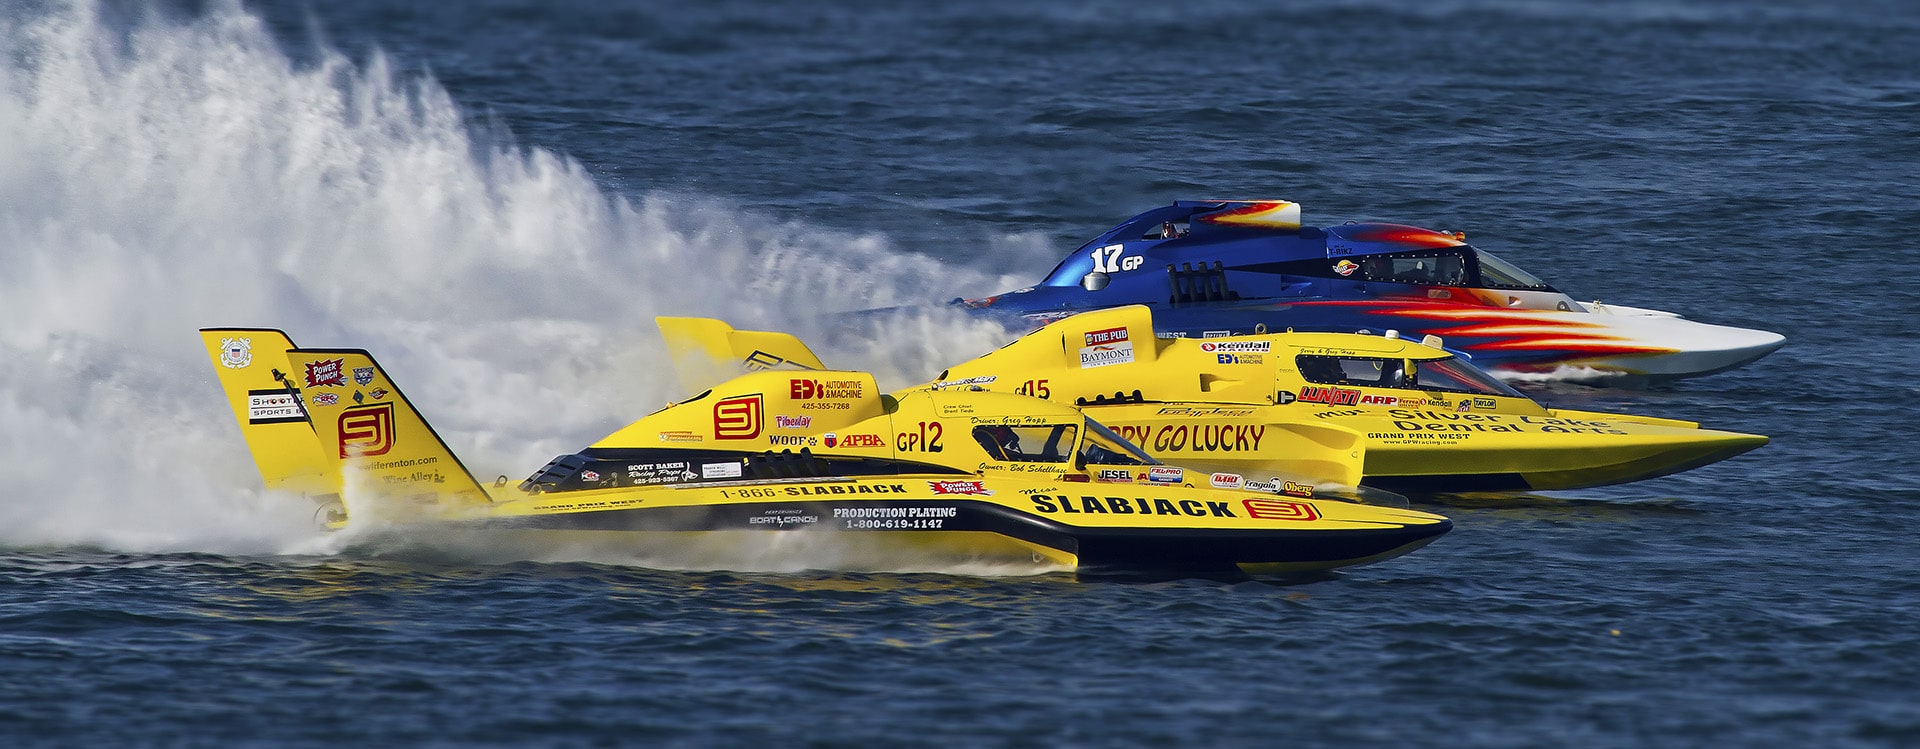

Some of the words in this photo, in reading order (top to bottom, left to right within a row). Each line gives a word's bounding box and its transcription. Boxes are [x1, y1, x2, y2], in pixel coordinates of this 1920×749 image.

[1093, 332, 1109, 342] THE
[1110, 329, 1127, 340] PUB
[1217, 341, 1270, 349] Kendall
[1080, 348, 1133, 363] BAYMONT
[313, 362, 337, 375] POWER
[315, 370, 338, 383] PUNCH
[825, 380, 862, 389] AUTOMOTIVE
[1297, 386, 1361, 407] LUNATI
[1360, 395, 1398, 405] ARP
[801, 402, 850, 410] 425-355-7268
[253, 408, 292, 416] SPORTS
[970, 416, 1000, 425] Driver:
[1002, 415, 1021, 425] Greg
[1024, 415, 1047, 424] Hopp
[1388, 409, 1501, 422] Silver
[1520, 415, 1611, 427] Lake
[1393, 420, 1524, 433] Dental
[1541, 425, 1628, 435] Arts
[769, 435, 806, 446] WOOF
[839, 434, 886, 447] APBA
[1154, 424, 1188, 451] GO
[1192, 424, 1265, 452] LUCKY
[628, 463, 654, 472] SCOTT
[655, 462, 684, 470] BAKER
[978, 462, 1007, 471] Owner:
[1010, 464, 1026, 472] Bob
[1097, 469, 1133, 479] JESEL
[1214, 475, 1240, 483] DART
[1244, 480, 1277, 489] Fragola
[1283, 481, 1313, 496] Oberg
[1030, 494, 1238, 518] SLABJACK
[833, 507, 907, 518] PRODUCTION
[908, 507, 957, 518] PLATING
[749, 516, 777, 524] BOAT
[783, 515, 818, 523] CANDY
[846, 519, 943, 529] 1-800-619-1147
